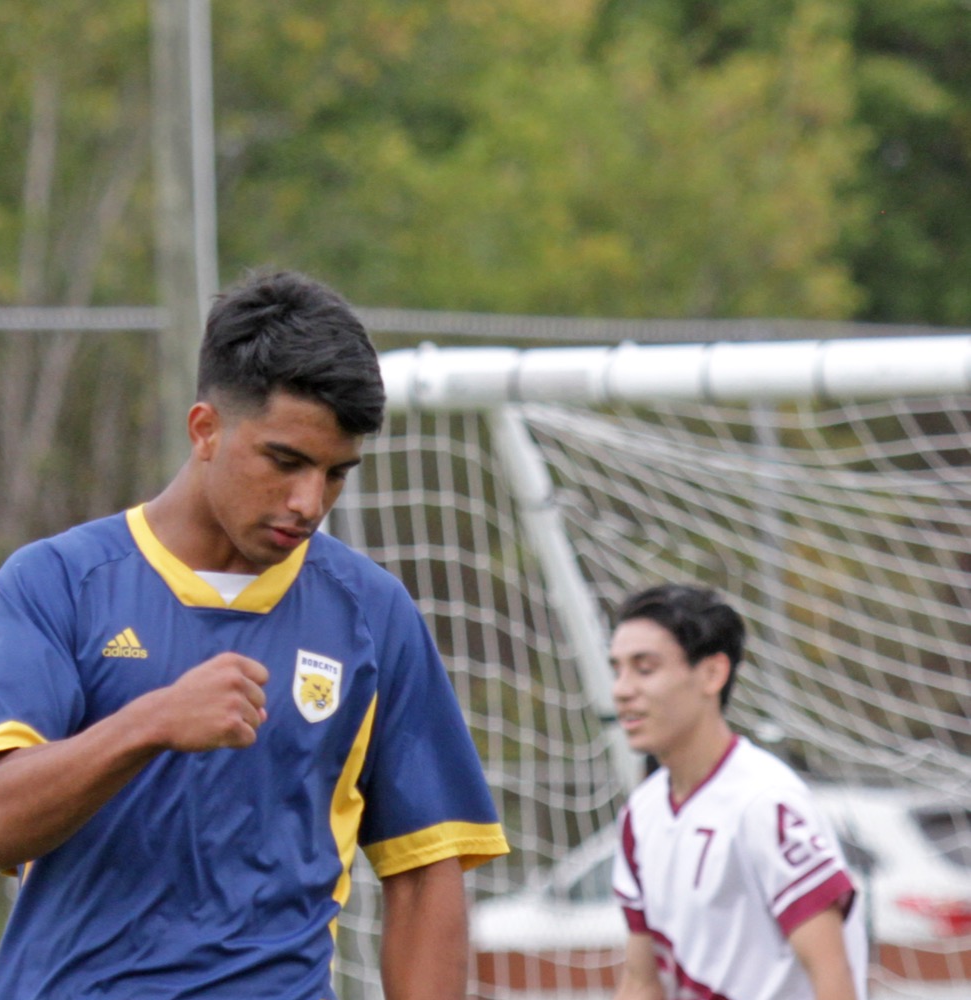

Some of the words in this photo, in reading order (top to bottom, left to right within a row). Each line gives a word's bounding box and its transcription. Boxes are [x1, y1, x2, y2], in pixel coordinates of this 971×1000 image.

[101, 646, 148, 659] adidas
[301, 656, 338, 675] BOBCATS
[694, 826, 716, 890] 7
